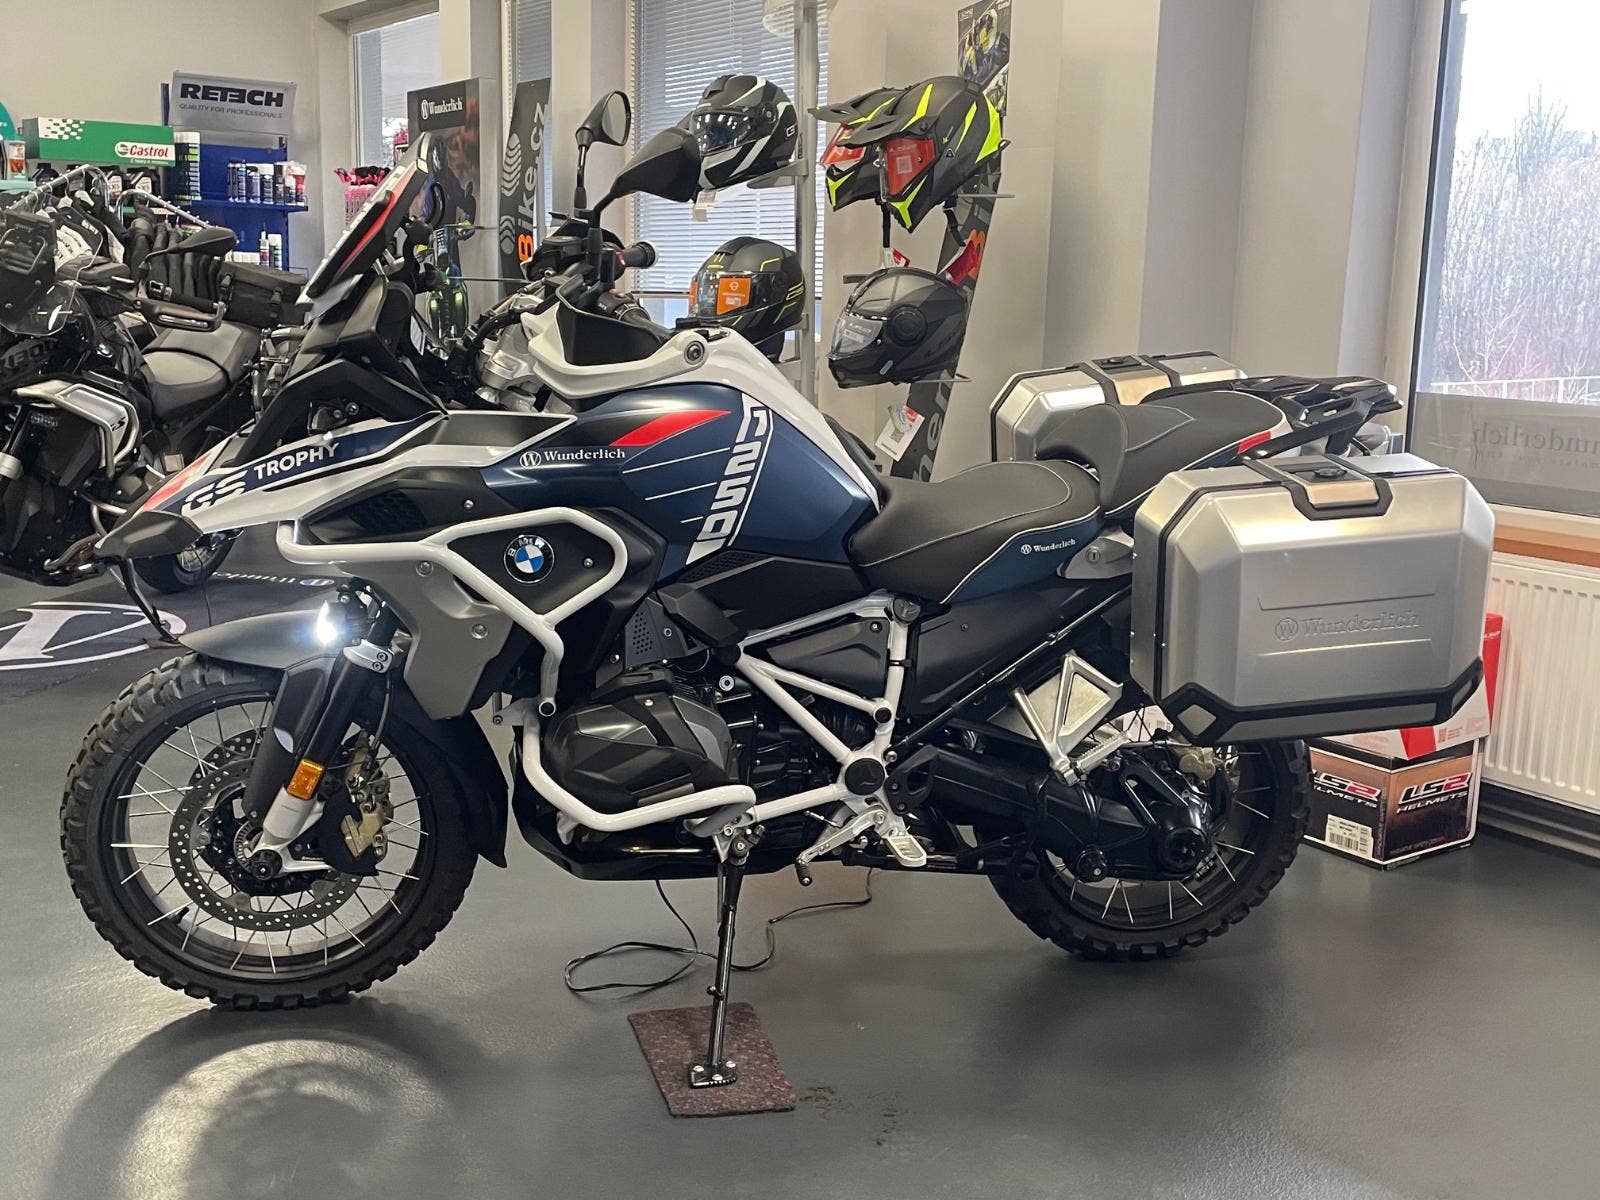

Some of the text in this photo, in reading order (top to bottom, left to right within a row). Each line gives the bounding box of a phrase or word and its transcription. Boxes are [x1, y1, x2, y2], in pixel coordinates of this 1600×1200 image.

[179, 103, 283, 119] QUALITY FOR PROFESSIONALS
[429, 97, 463, 115] Wunderlich
[130, 144, 169, 158] Castrol
[544, 448, 626, 462] Wunderlich
[181, 442, 340, 517] GS TROPHY
[1033, 538, 1076, 553] Wunderlich
[1302, 609, 1422, 637] Wunderlich
[1314, 785, 1378, 808] LMETS
[1398, 772, 1472, 804] LS2
[1396, 790, 1468, 814] HELMETS
